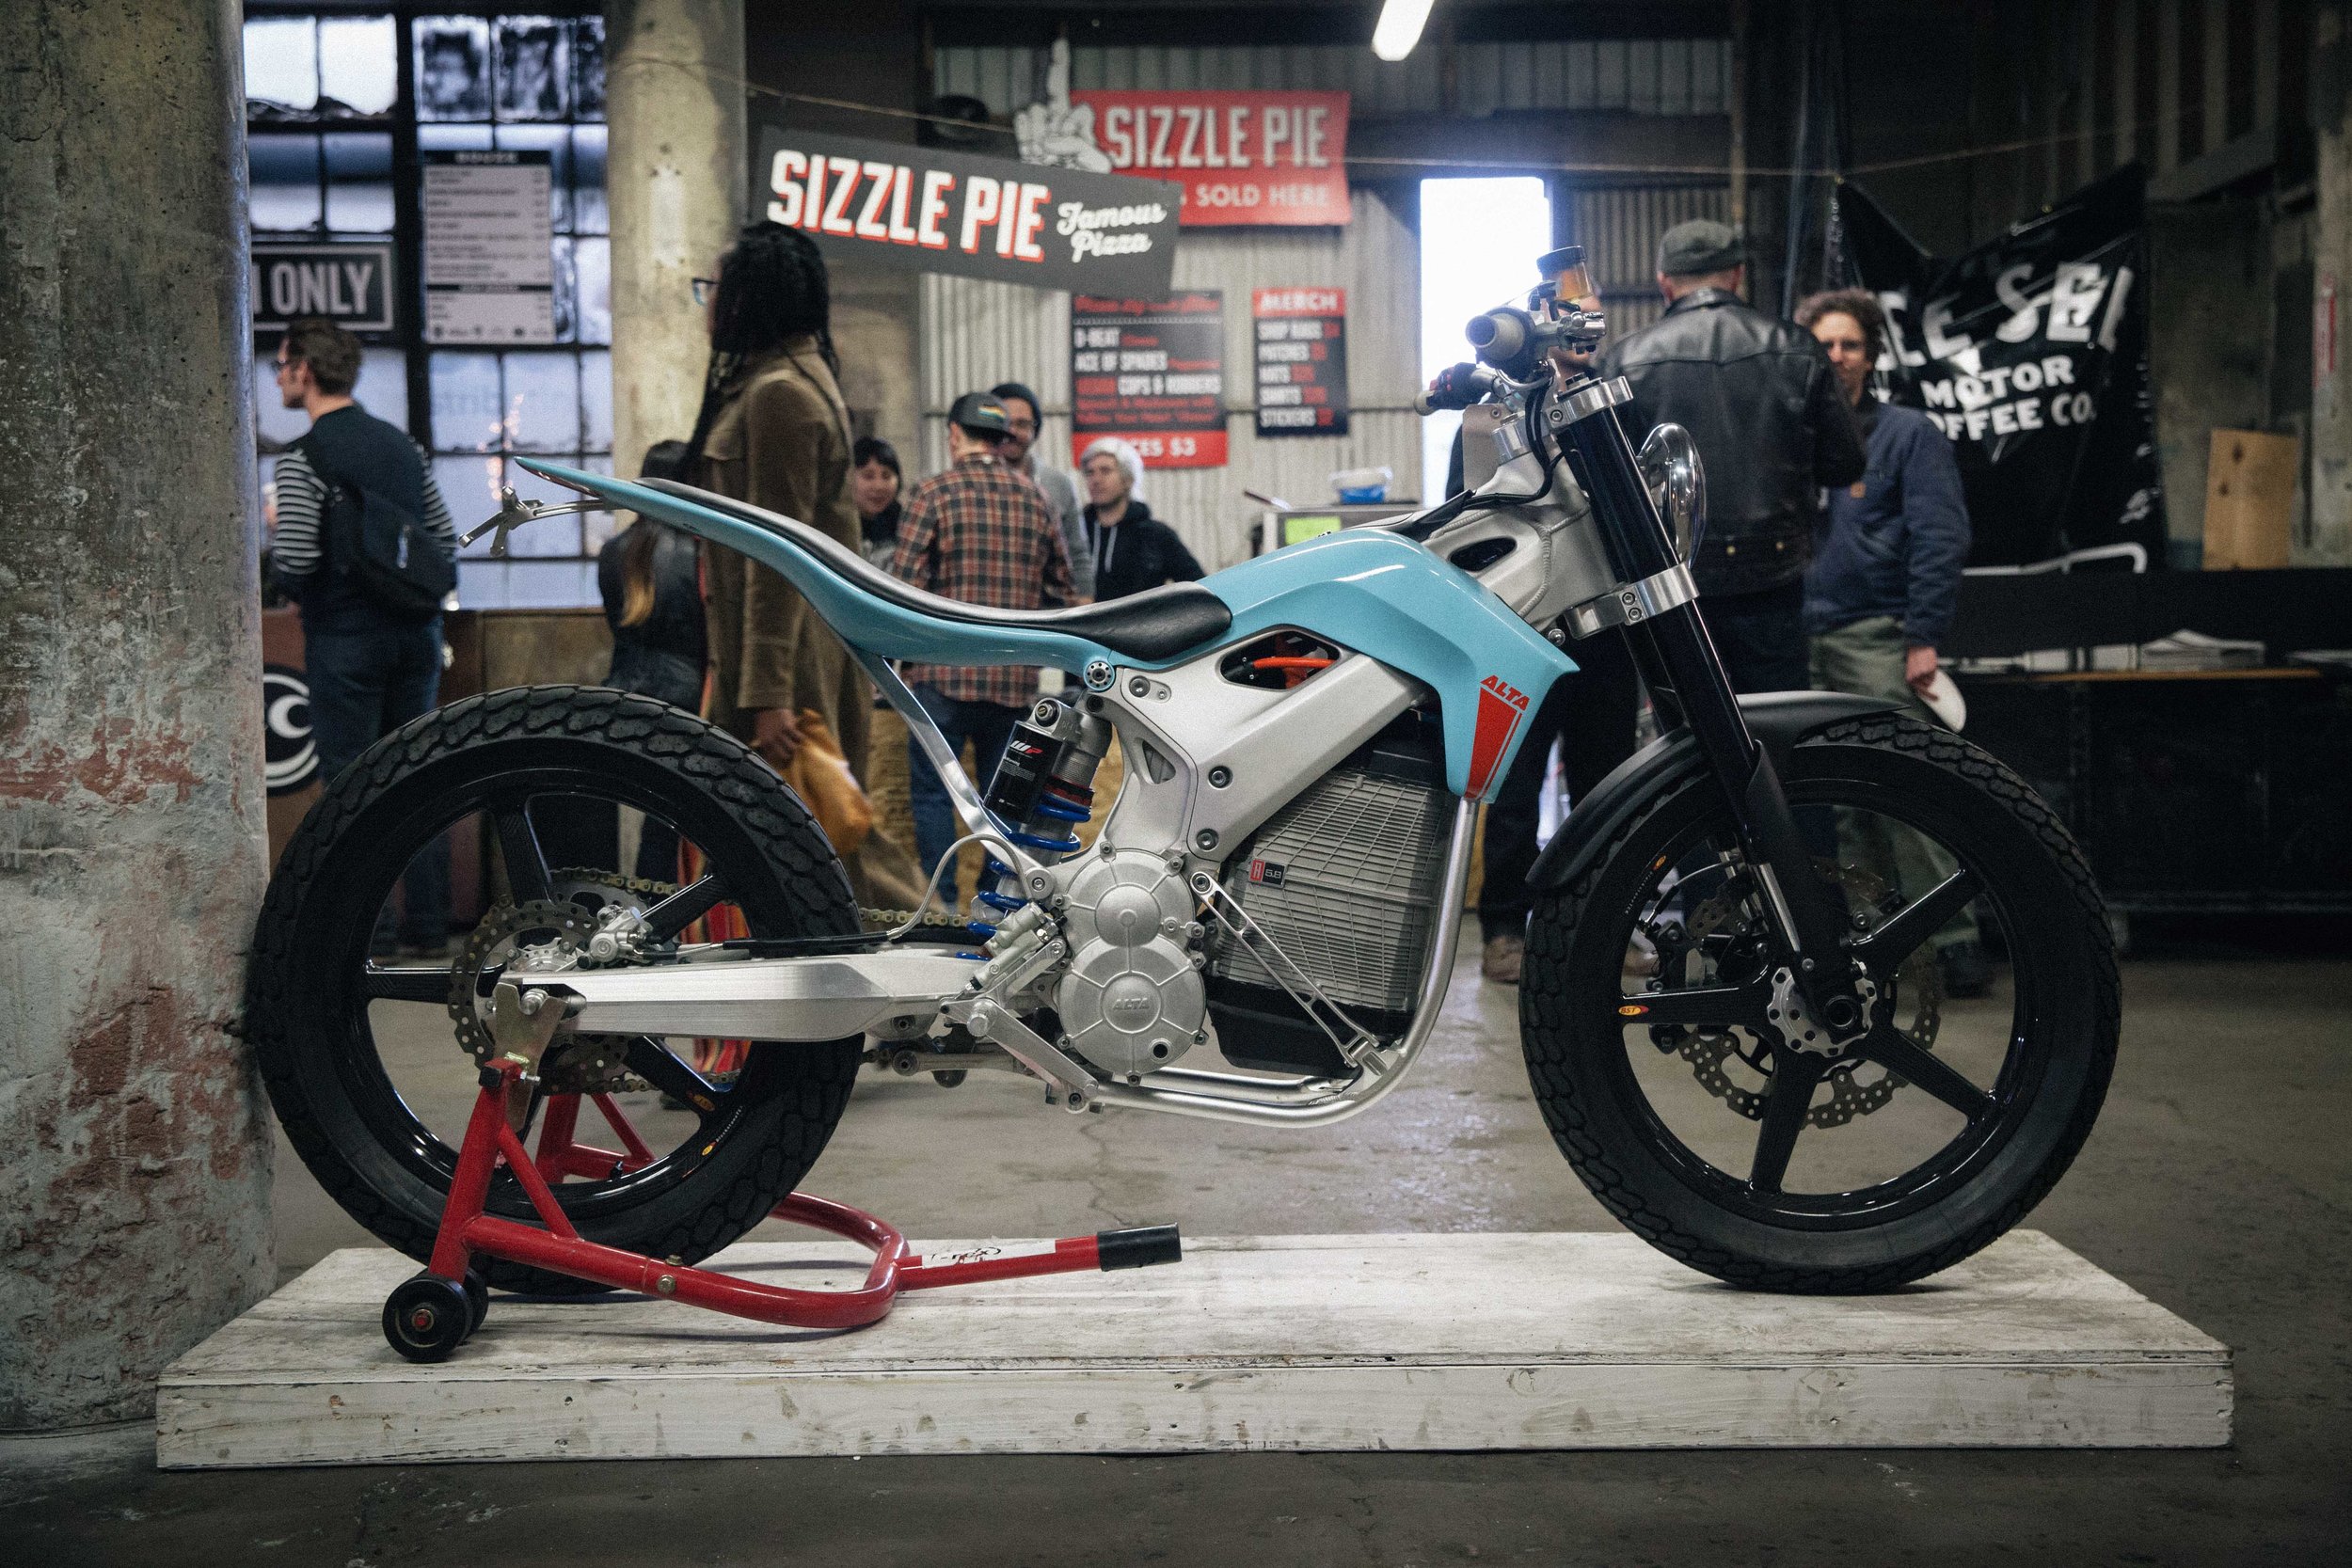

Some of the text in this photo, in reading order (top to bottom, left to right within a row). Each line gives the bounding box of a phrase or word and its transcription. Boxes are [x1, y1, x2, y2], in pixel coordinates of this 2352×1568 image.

[1105, 106, 1329, 168] SIZZLE PIE
[767, 150, 1052, 263] SIZZLE PIE
[1196, 183, 1261, 208] SOLD
[1271, 184, 1328, 208] HERE
[1057, 200, 1168, 236] Famous
[1071, 230, 1153, 263] Pizza
[270, 261, 373, 314] ONLY
[1261, 293, 1338, 311] MERCH
[1920, 355, 2075, 412] MOTOR
[1260, 406, 1317, 428] STICKERS
[1169, 437, 1197, 458] $3
[1480, 674, 1531, 711] ALTA
[1265, 869, 1282, 879] 5.8
[1112, 998, 1150, 1010] ALTA
